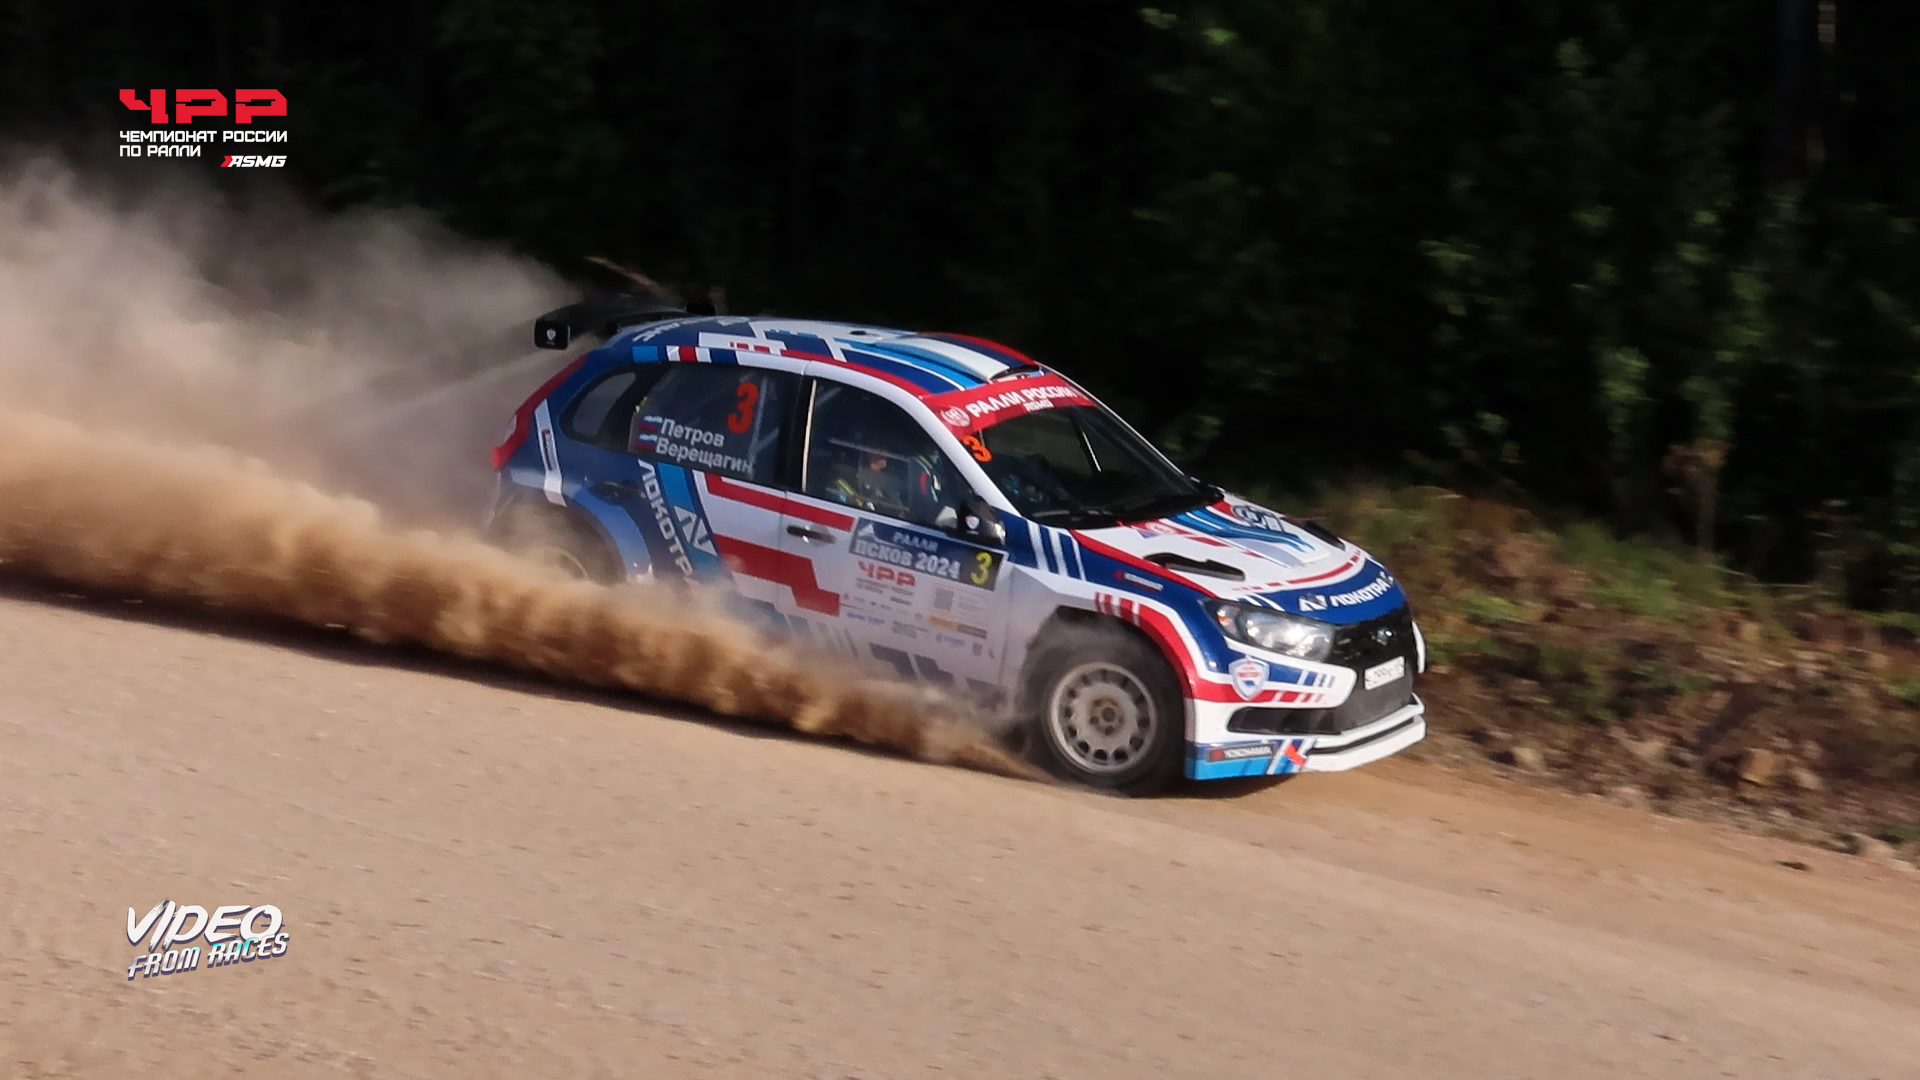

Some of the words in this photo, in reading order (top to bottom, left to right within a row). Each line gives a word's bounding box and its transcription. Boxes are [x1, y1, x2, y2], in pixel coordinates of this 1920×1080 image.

[727, 381, 759, 434] 3
[965, 390, 1026, 417] РАЛЛИ
[1020, 385, 1077, 401] РОССИИ
[660, 417, 725, 448] Петров
[655, 436, 754, 474] Верещагин
[962, 435, 992, 463] 3
[893, 531, 938, 552] РАЛЛИ
[854, 539, 913, 567] ПСКОВ
[915, 551, 961, 580] 2024
[858, 560, 916, 587] ЧРР
[970, 551, 993, 585] 3
